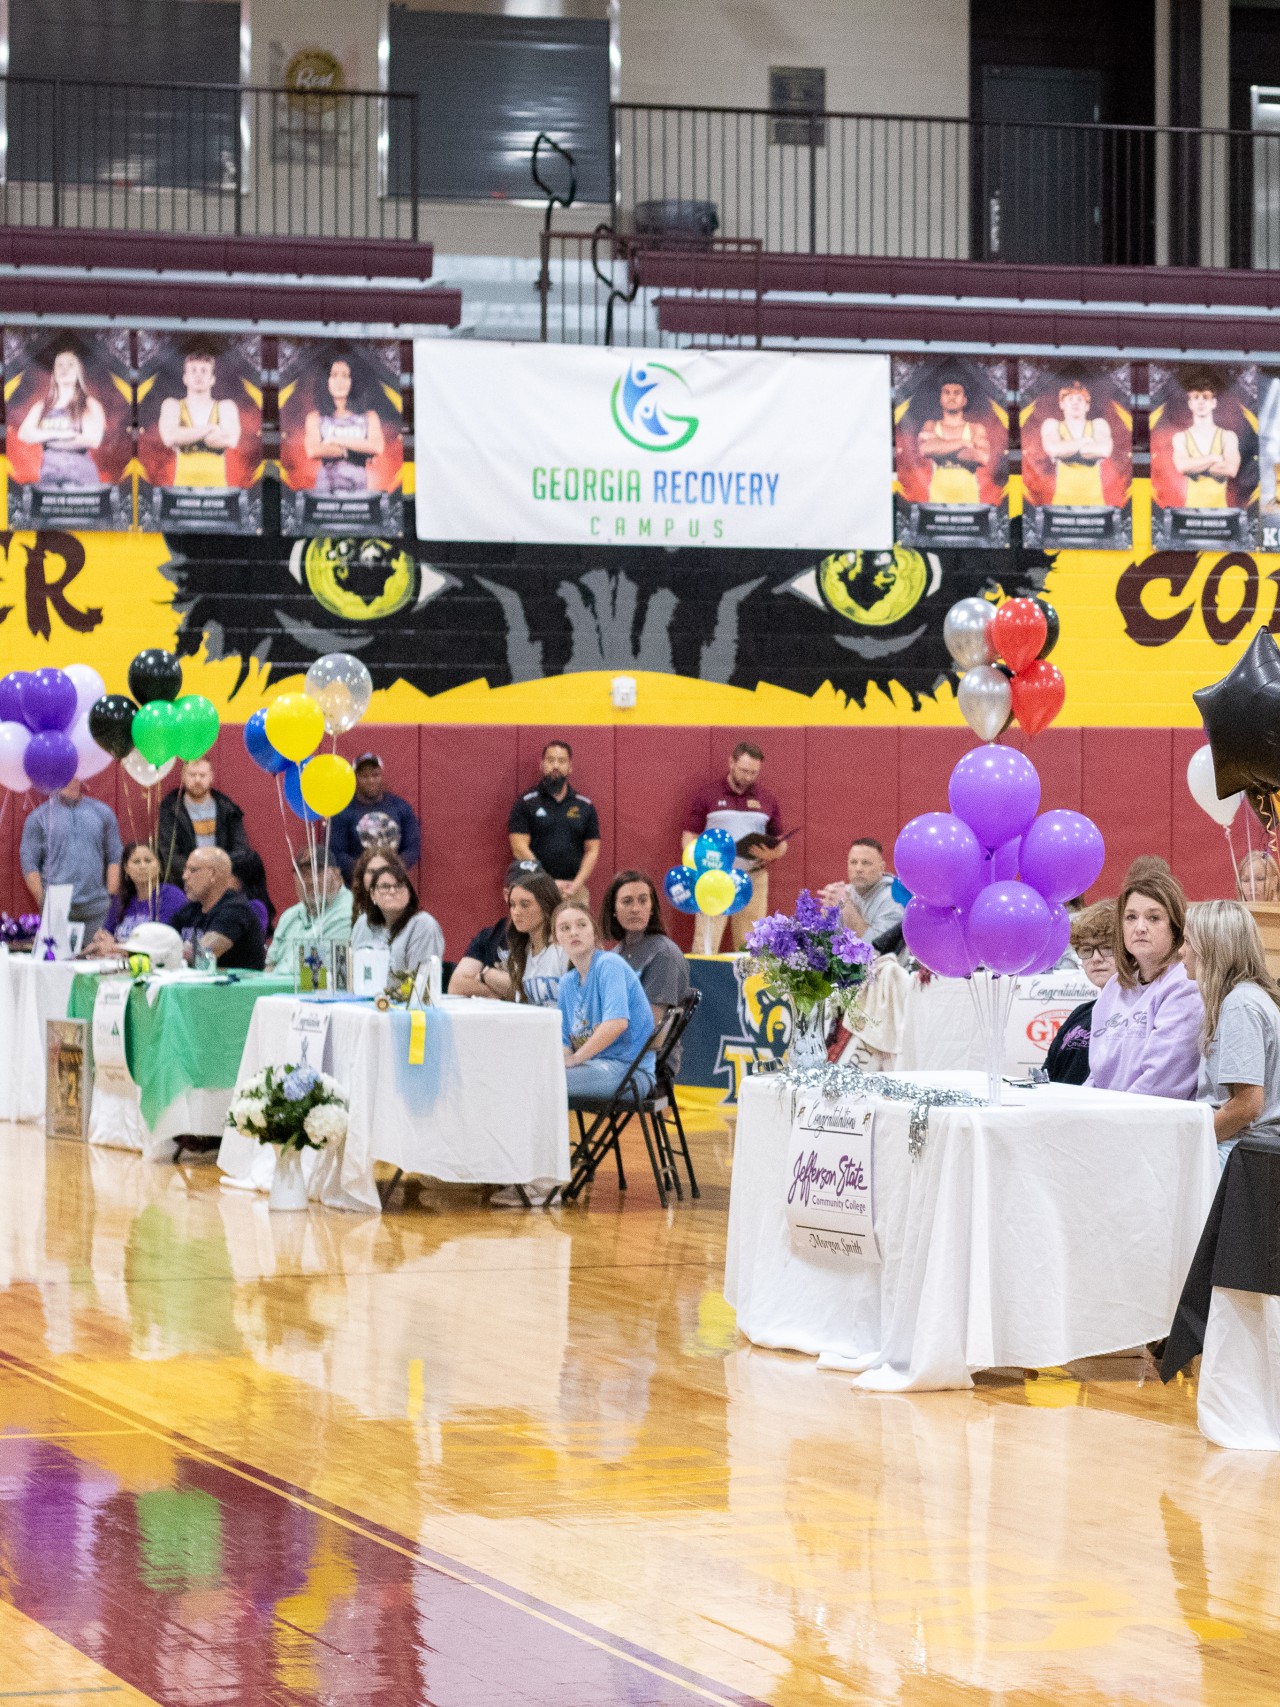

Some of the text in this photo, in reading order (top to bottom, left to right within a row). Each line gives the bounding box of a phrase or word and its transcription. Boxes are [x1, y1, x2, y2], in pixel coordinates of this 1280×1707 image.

[533, 466, 779, 506] GEORGIA RECOVERY
[590, 516, 723, 538] CAMPUS
[788, 1149, 868, 1208] Jefferson State
[811, 1194, 867, 1214] Community College
